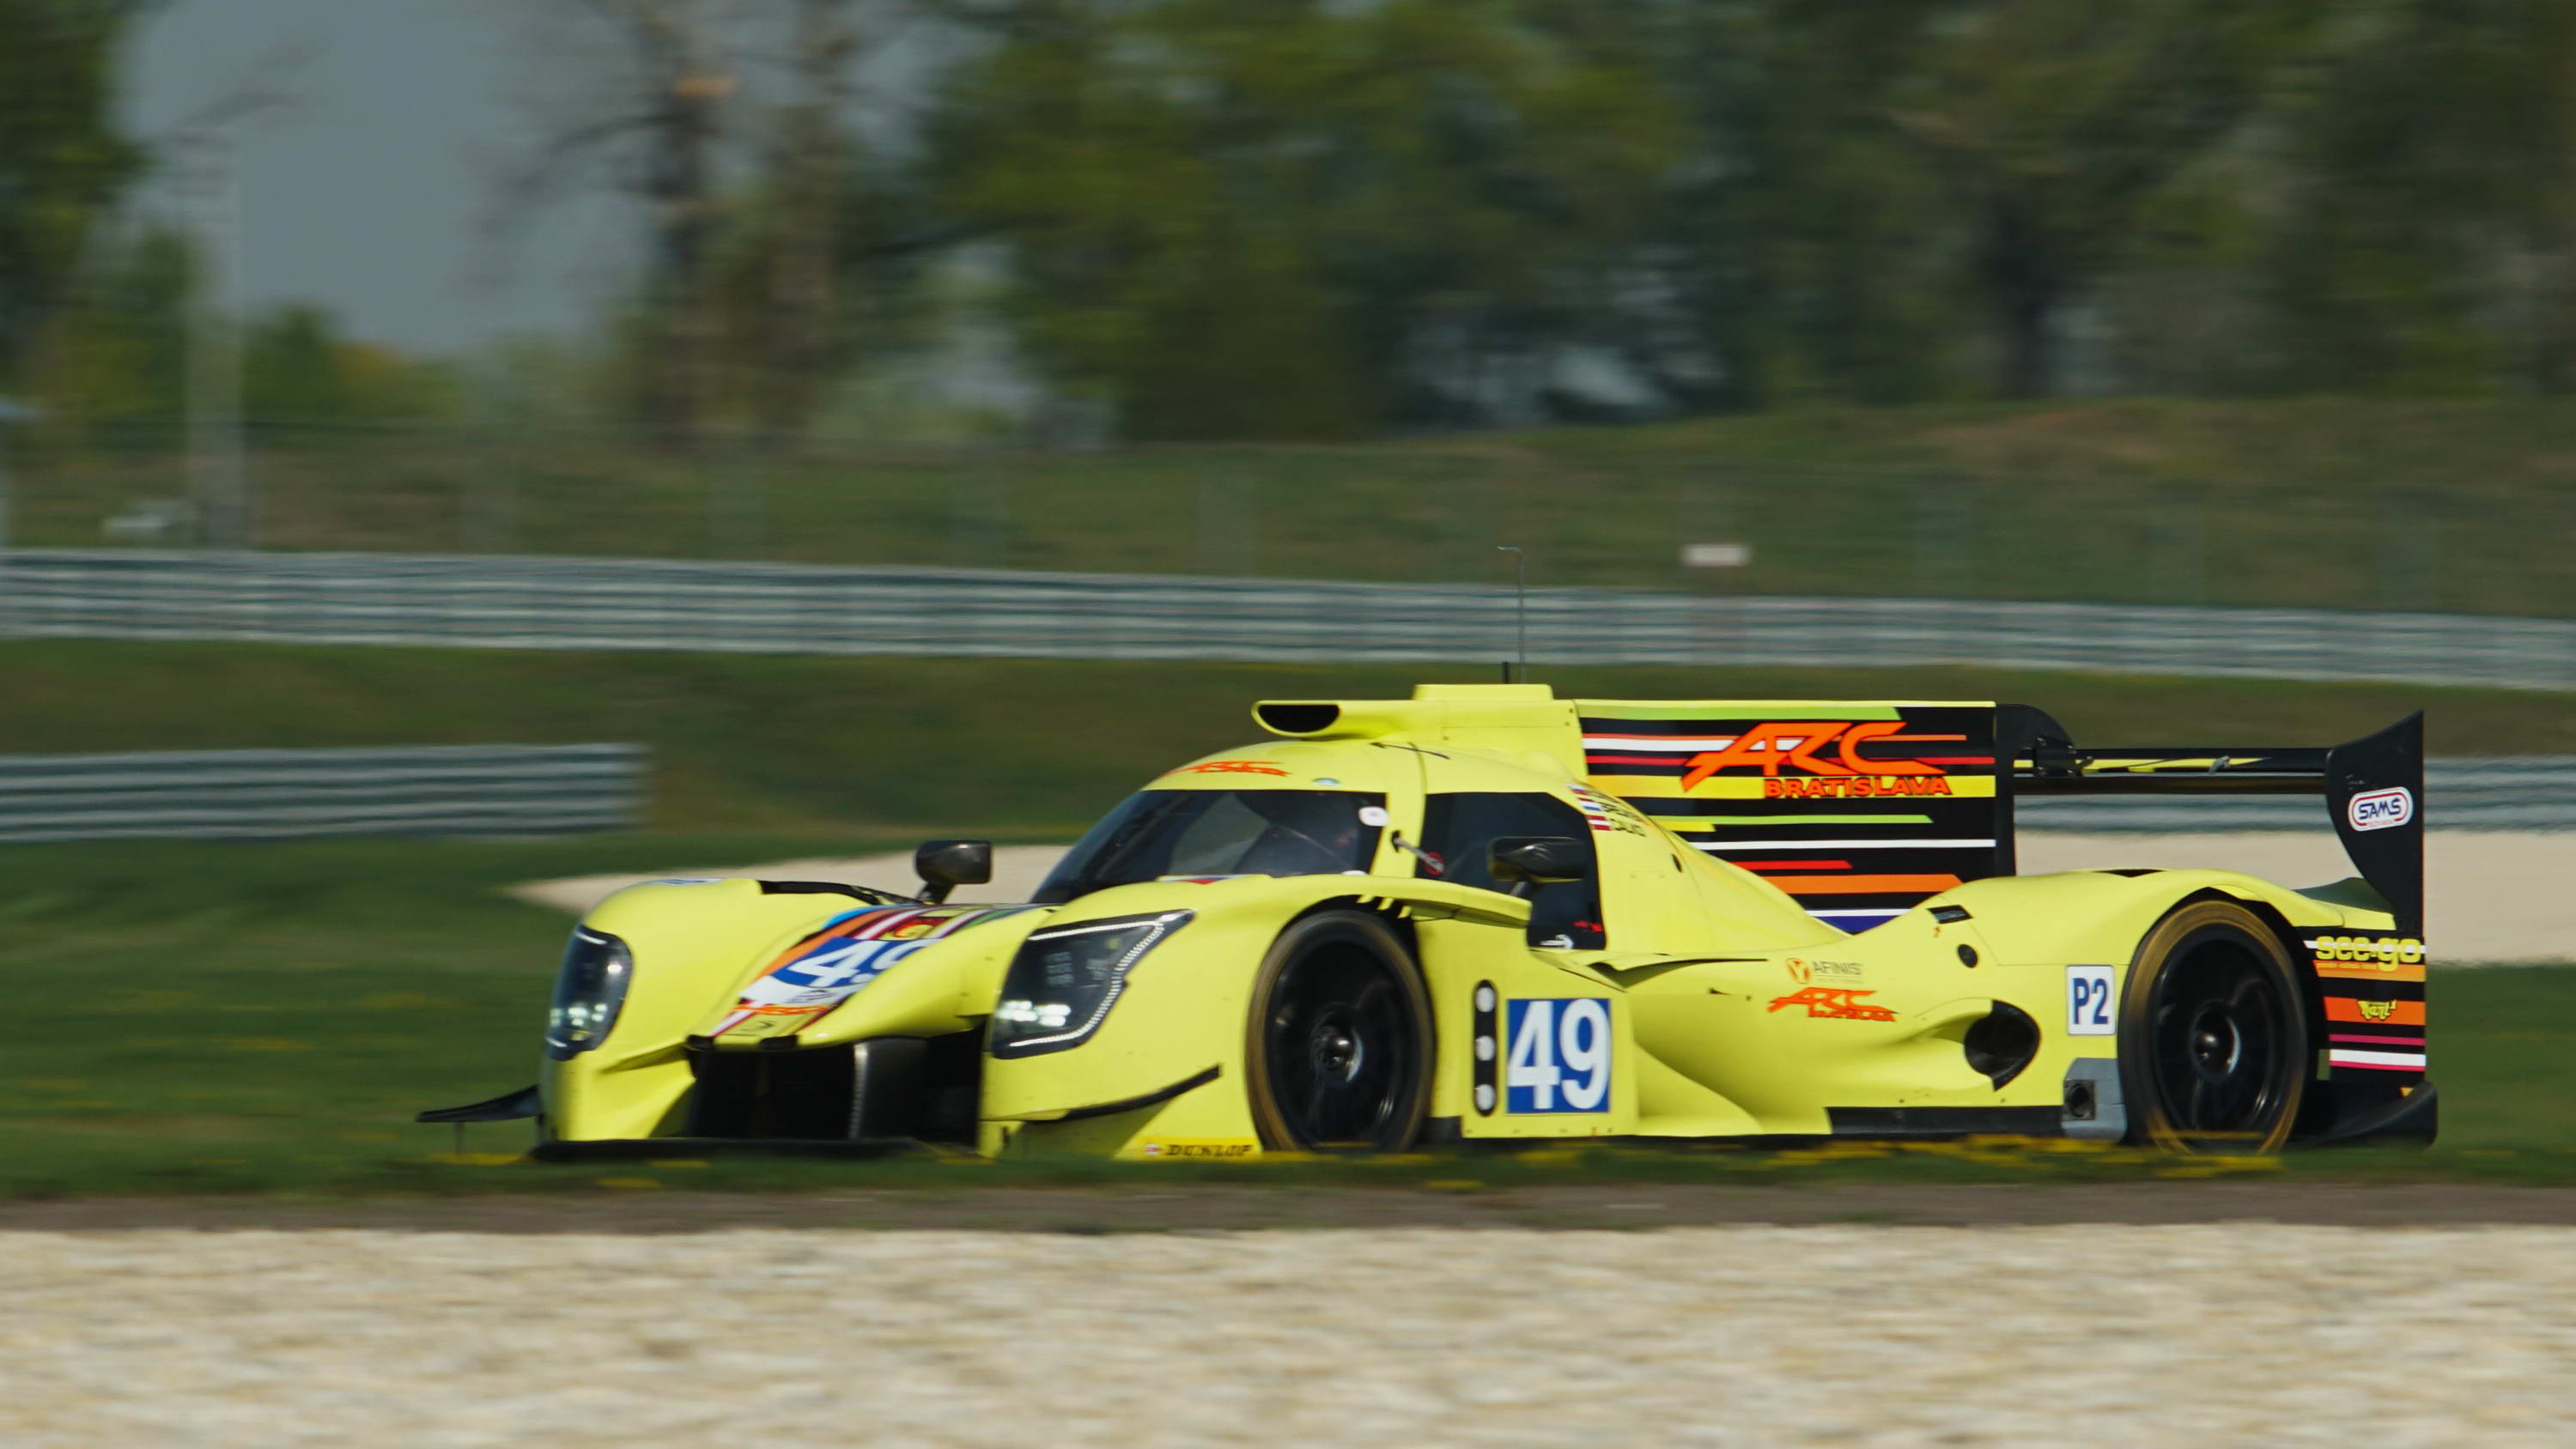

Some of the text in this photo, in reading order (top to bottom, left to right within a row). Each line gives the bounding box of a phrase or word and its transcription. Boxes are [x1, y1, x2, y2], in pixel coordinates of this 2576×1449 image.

[1763, 774, 1953, 799] BRATISLAVA
[2316, 936, 2421, 972] see-go
[2072, 977, 2109, 1025] P2
[1508, 997, 1612, 1109] 49
[1164, 1143, 1253, 1156] DUNLOP
